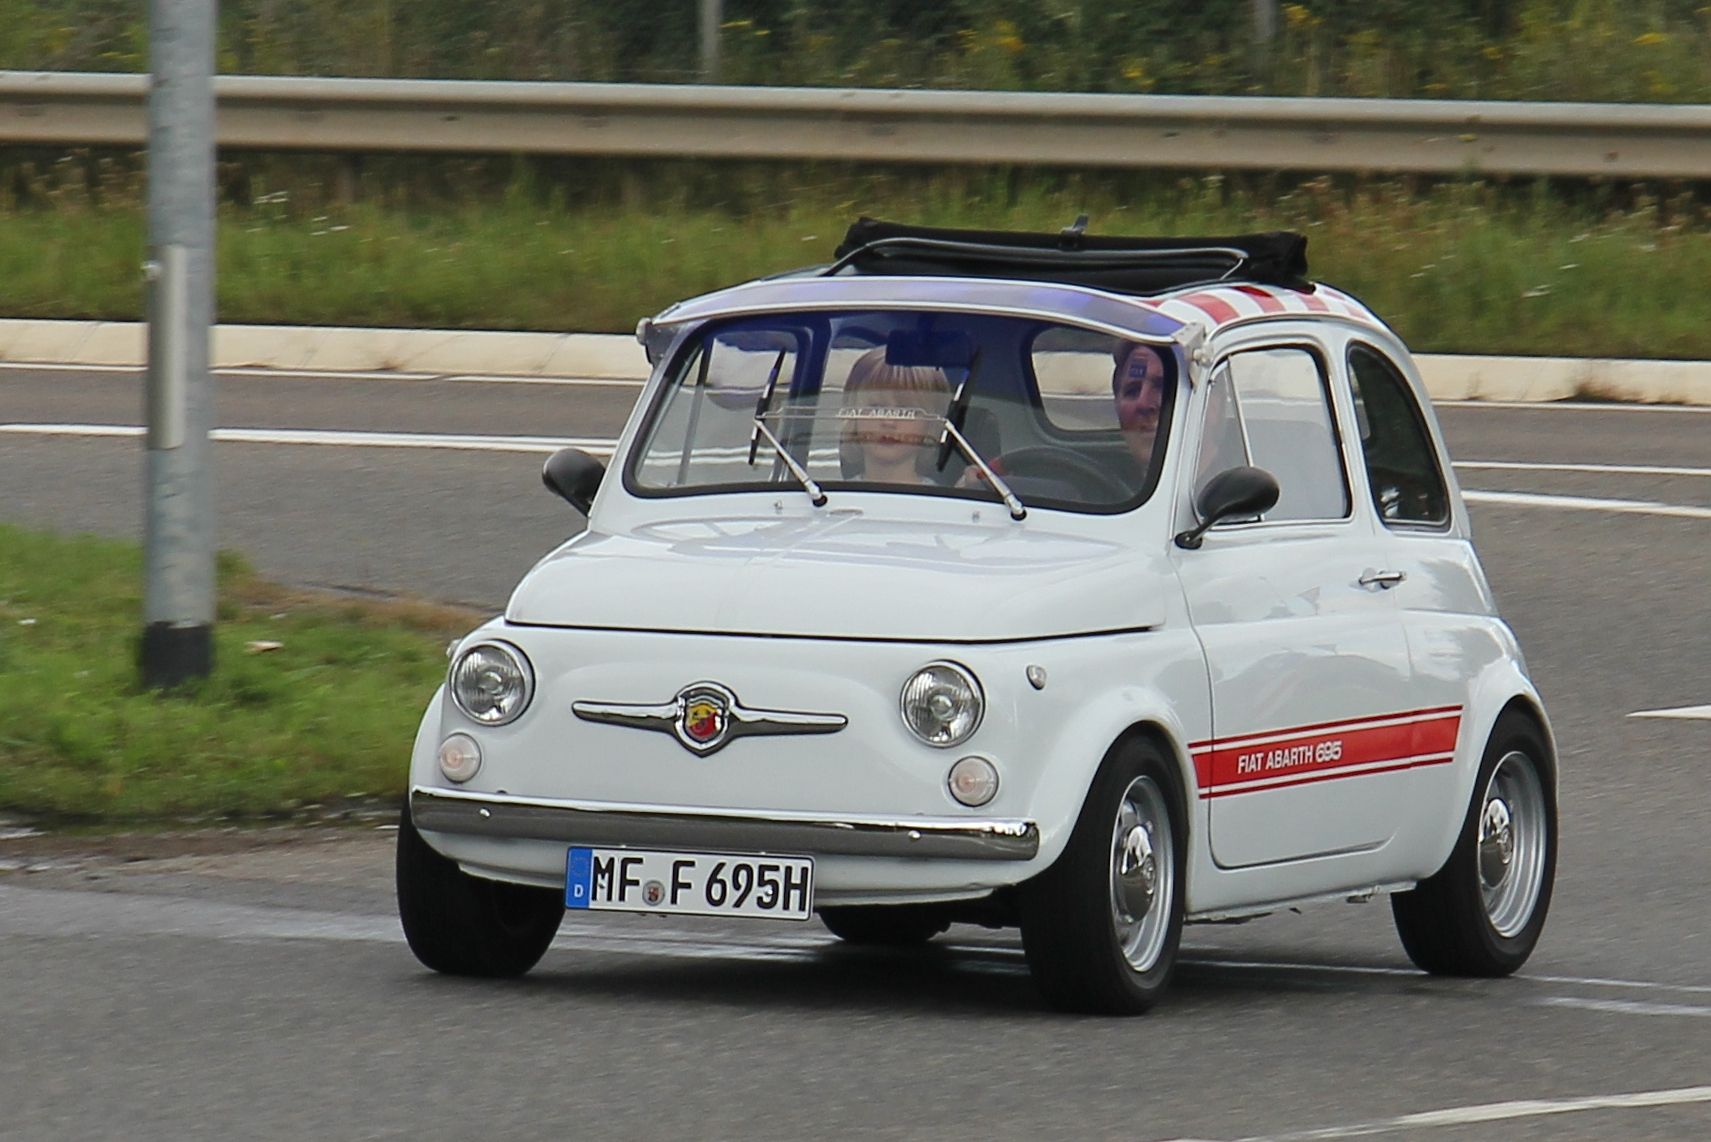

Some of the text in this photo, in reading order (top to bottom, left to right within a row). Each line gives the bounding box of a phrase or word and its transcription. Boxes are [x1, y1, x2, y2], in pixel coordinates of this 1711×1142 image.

[1237, 740, 1342, 774] FIAT ABARTH 695
[574, 884, 584, 898] D
[591, 856, 809, 912] MF F 695H
